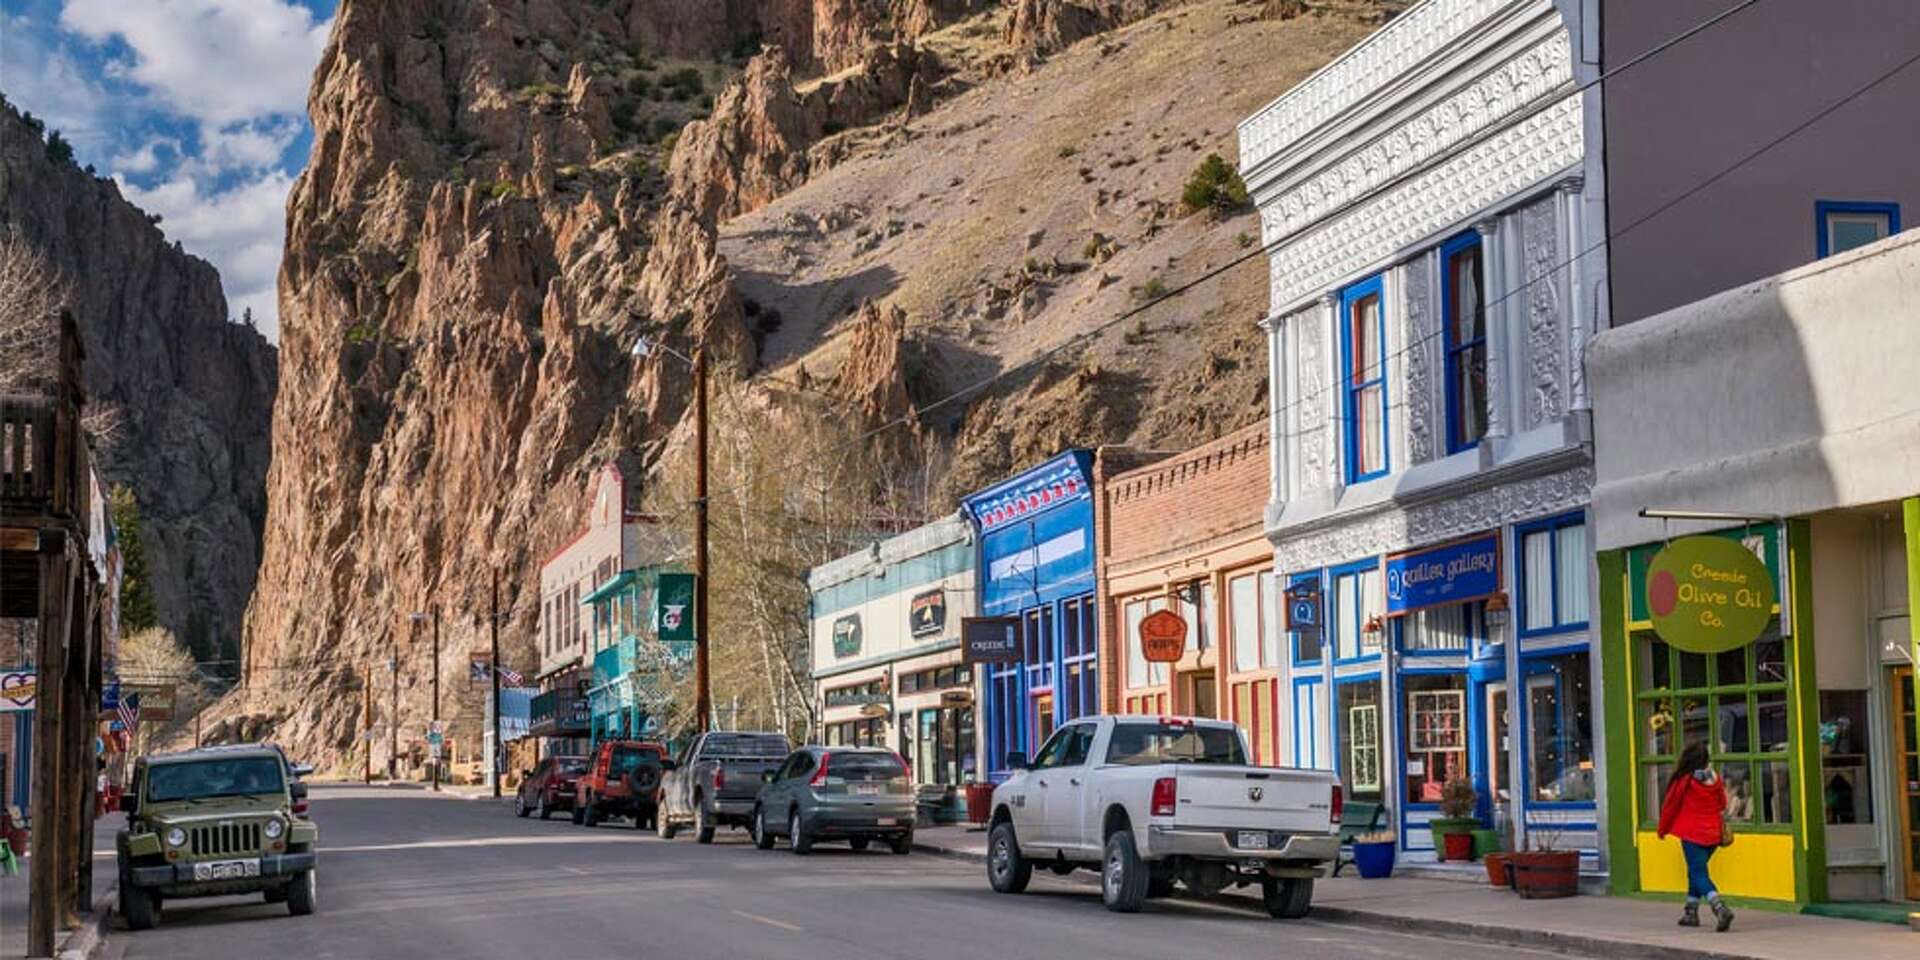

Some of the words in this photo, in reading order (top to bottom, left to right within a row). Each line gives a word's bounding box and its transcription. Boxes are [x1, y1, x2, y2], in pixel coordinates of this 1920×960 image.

[1679, 583, 1728, 604] Olive
[1735, 588, 1762, 608] Oil
[1700, 610, 1725, 628] Co.
